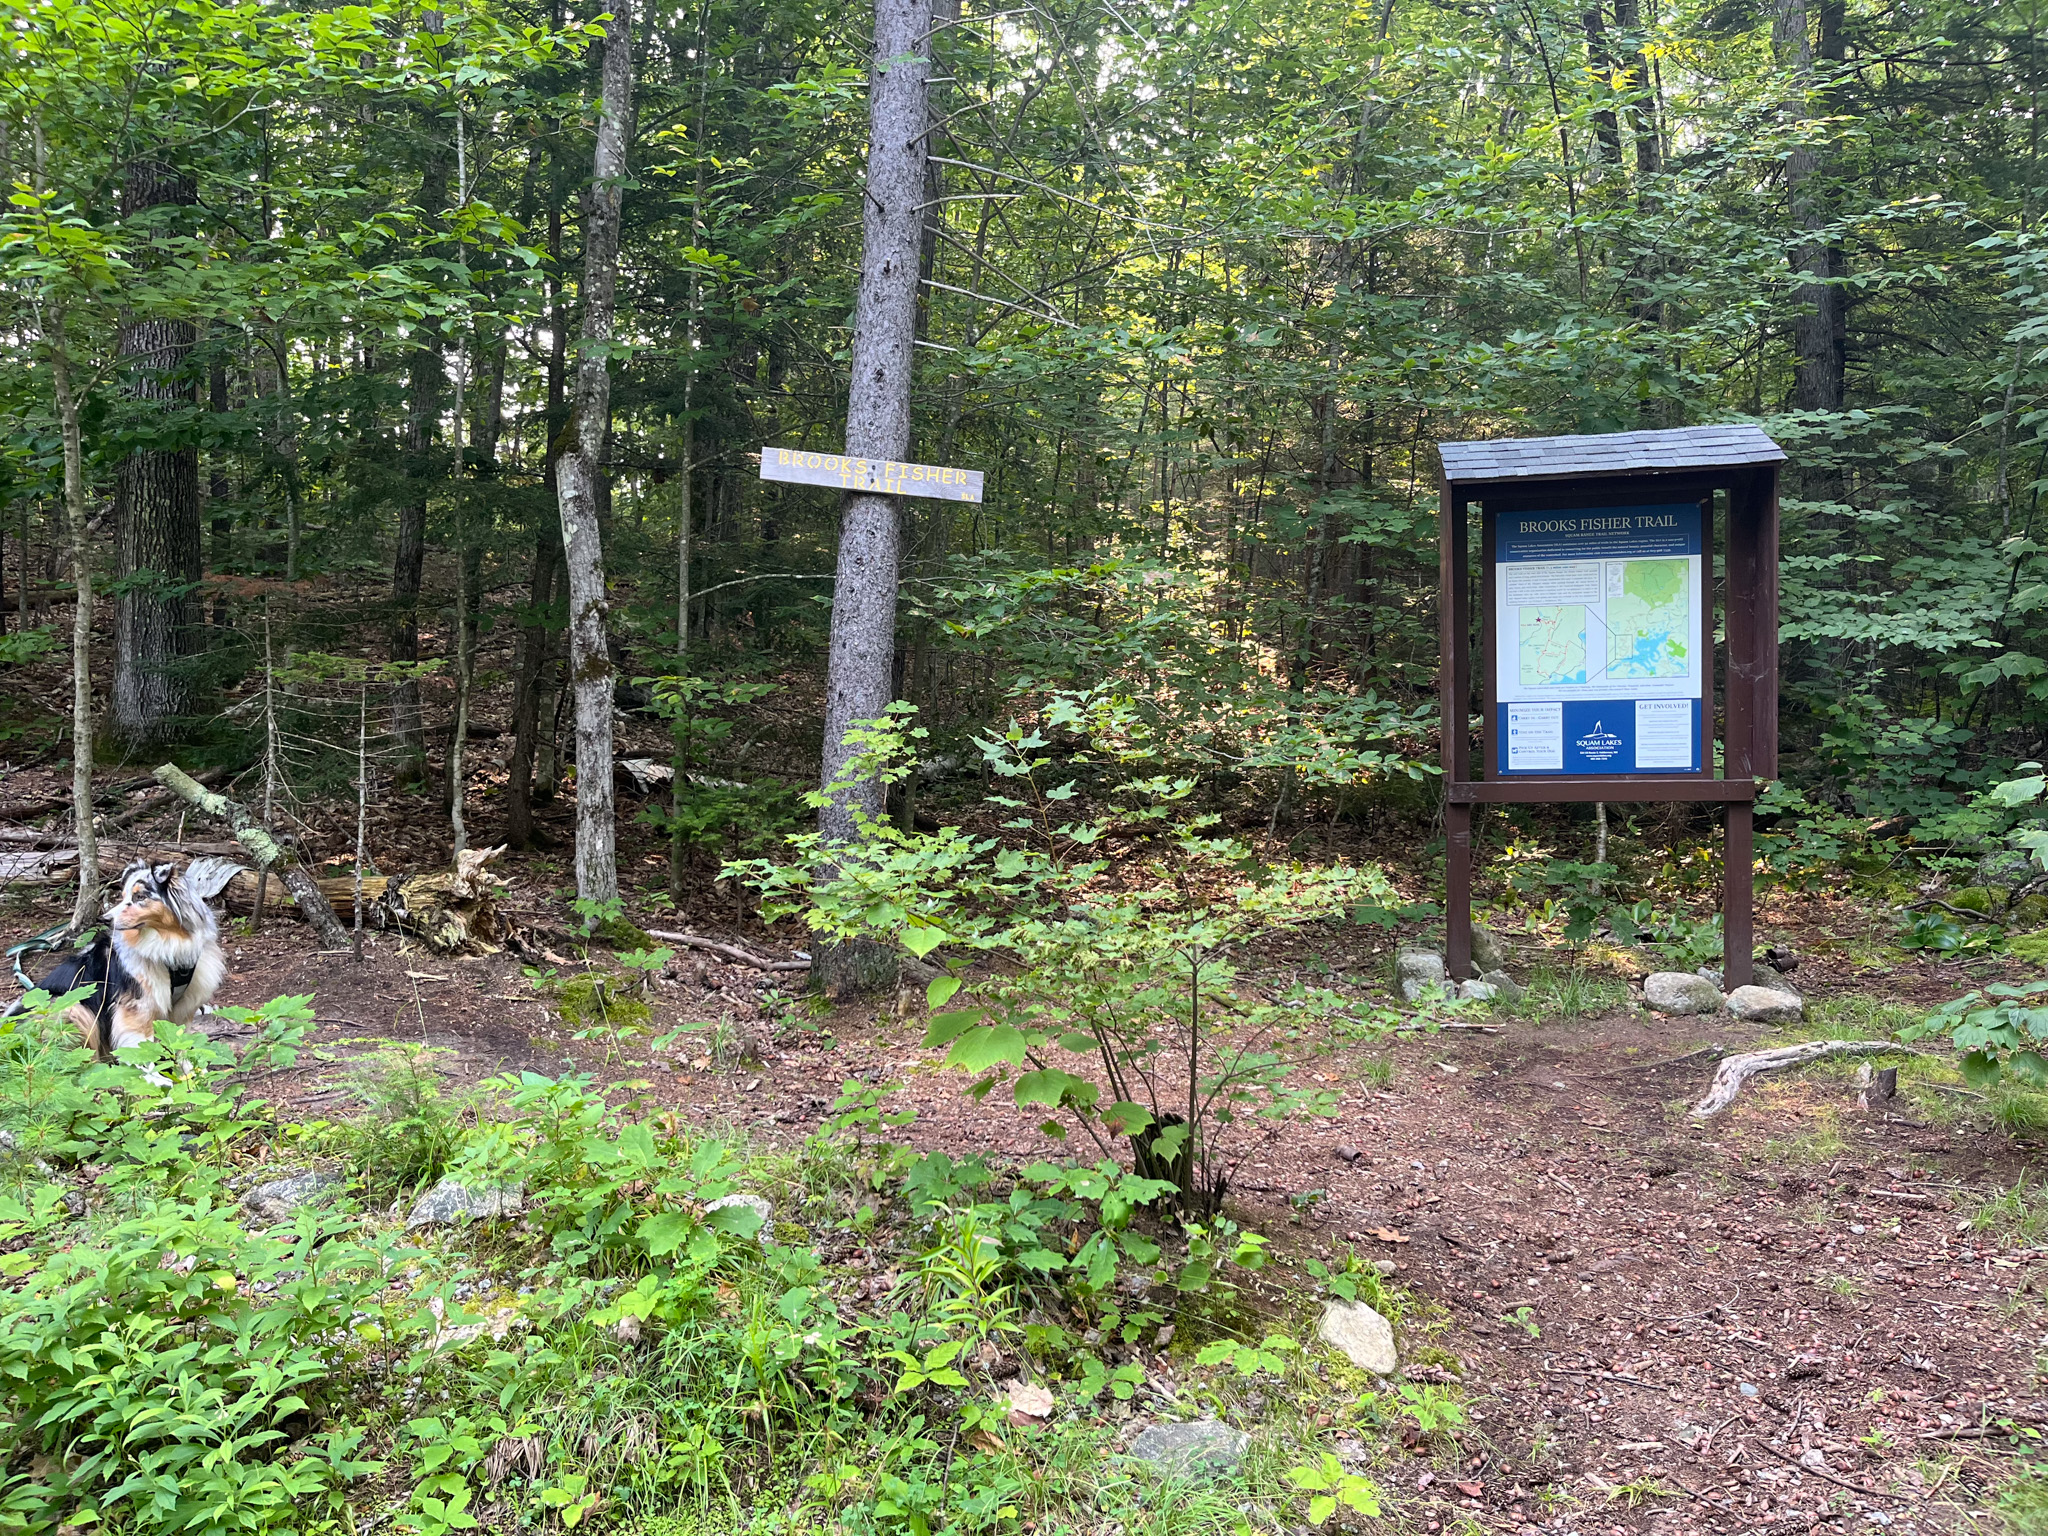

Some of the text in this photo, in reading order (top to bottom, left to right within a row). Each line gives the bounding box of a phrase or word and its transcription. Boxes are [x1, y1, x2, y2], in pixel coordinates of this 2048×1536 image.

[778, 450, 967, 485] BROOKS FISHER
[839, 473, 907, 494] TRAIL
[1519, 515, 1678, 533] BROOKS FISHER TRAIL
